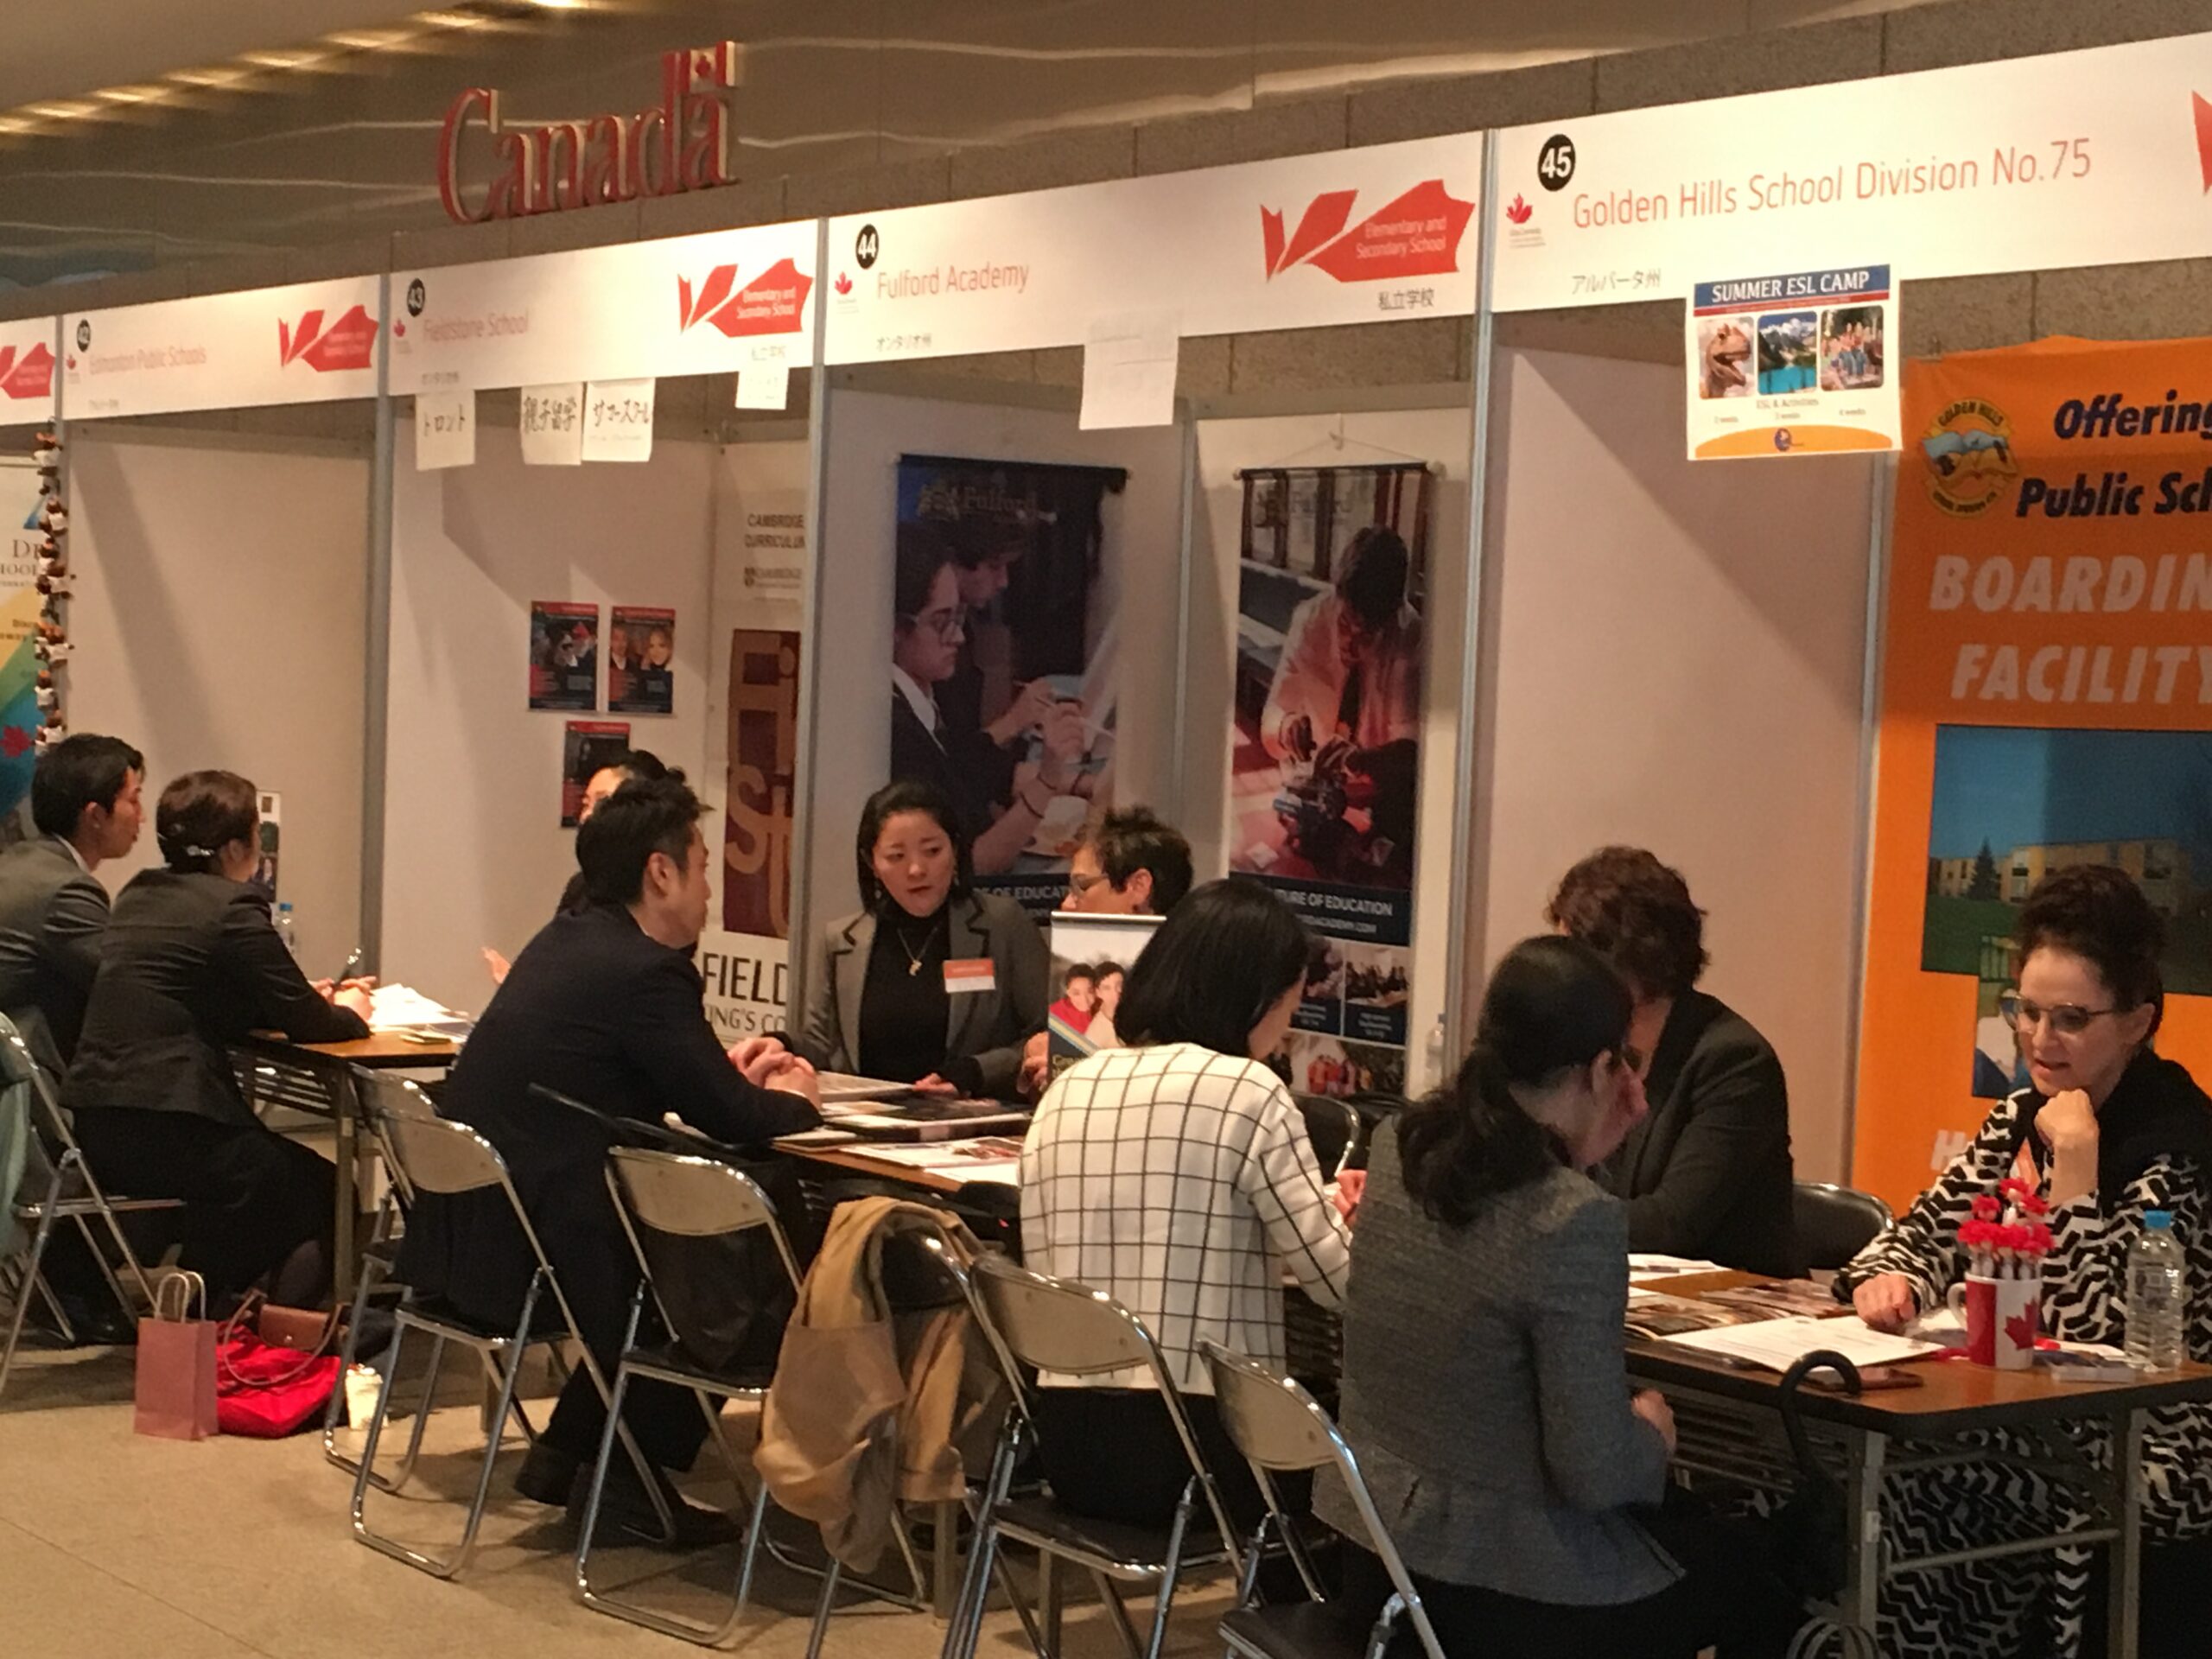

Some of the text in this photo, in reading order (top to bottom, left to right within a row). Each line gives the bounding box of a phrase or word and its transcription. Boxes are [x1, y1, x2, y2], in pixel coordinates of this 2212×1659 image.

[438, 50, 734, 225] Canada
[1541, 146, 1572, 179] 45
[1573, 137, 2091, 228] Golden Hills School Division No.75
[1364, 217, 1447, 238] Elementary and
[858, 232, 877, 260] 44
[1356, 235, 1446, 258] Secondary School
[877, 261, 1031, 299] Fulford Academy
[1572, 267, 1662, 295] アルバータ州
[1712, 270, 1870, 302] SUMMER ESL CAMP
[1378, 287, 1435, 310] 私立学校
[487, 307, 530, 337] School
[2015, 473, 2144, 518] Public
[1308, 892, 1324, 906] OF
[1325, 894, 1393, 916] EDUCATION
